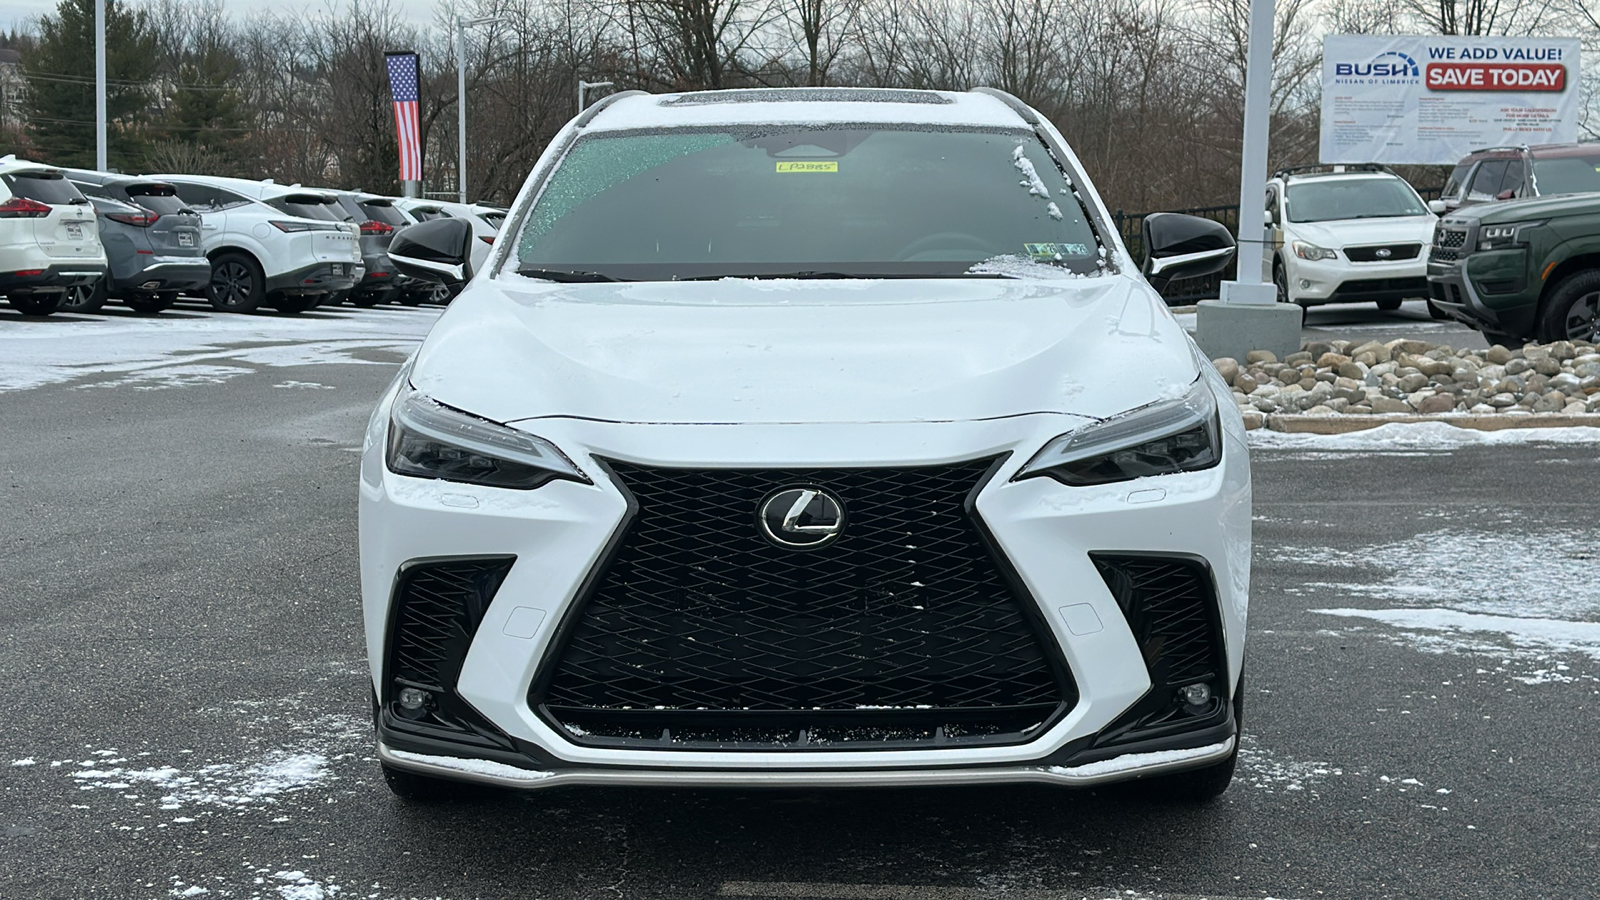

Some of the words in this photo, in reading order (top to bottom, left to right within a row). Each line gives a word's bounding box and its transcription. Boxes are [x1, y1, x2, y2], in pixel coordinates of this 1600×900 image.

[1428, 47, 1455, 59] WE
[1459, 47, 1498, 59] ADD
[1502, 48, 1562, 60] VALUE!
[1336, 63, 1408, 76] BUSH
[1429, 68, 1485, 85] SAVE
[1488, 68, 1561, 86] TODAY
